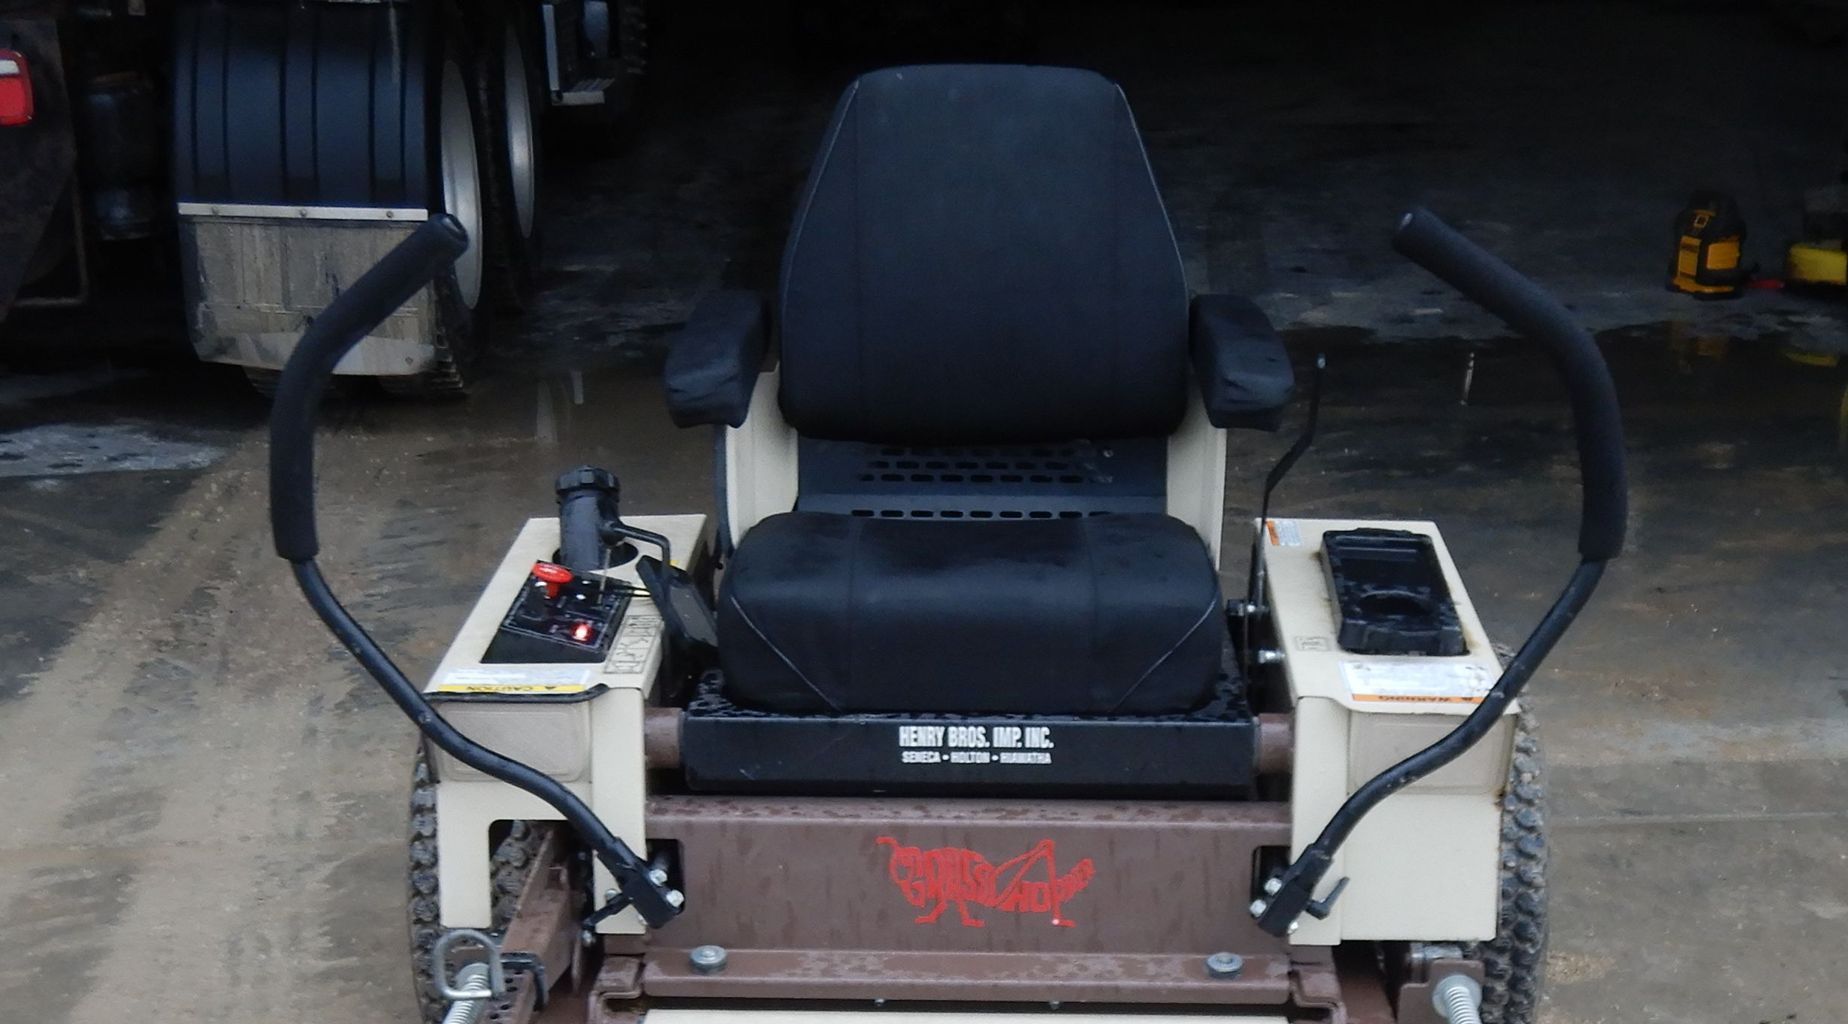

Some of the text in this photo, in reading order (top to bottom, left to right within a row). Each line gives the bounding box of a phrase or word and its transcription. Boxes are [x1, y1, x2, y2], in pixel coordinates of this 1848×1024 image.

[899, 725, 1054, 749] HENRY BROS. IMP. INC.
